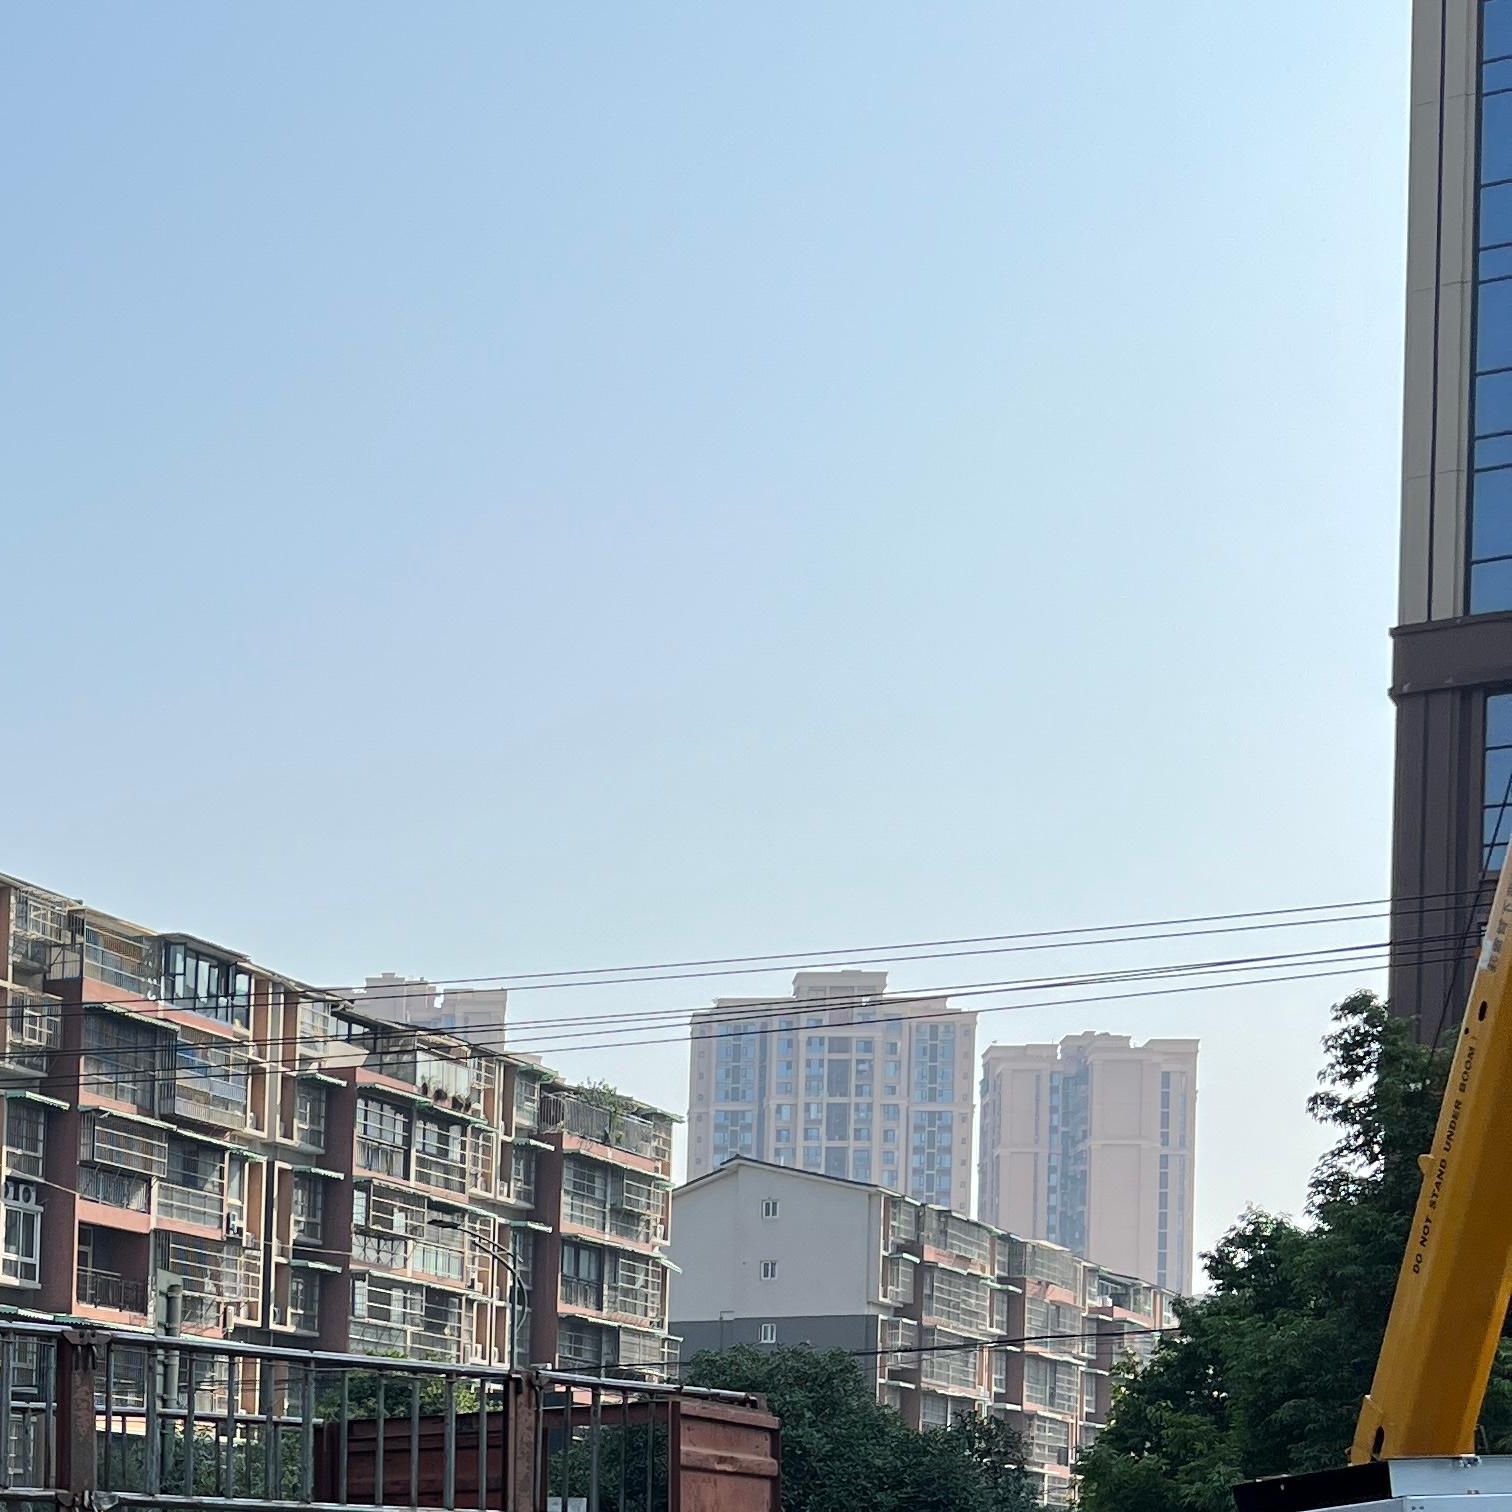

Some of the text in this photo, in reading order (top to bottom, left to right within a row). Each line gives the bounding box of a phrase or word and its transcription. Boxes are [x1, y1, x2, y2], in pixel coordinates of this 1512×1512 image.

[1412, 1045, 1476, 1274] DO NOT STAND UNDER BOOM
